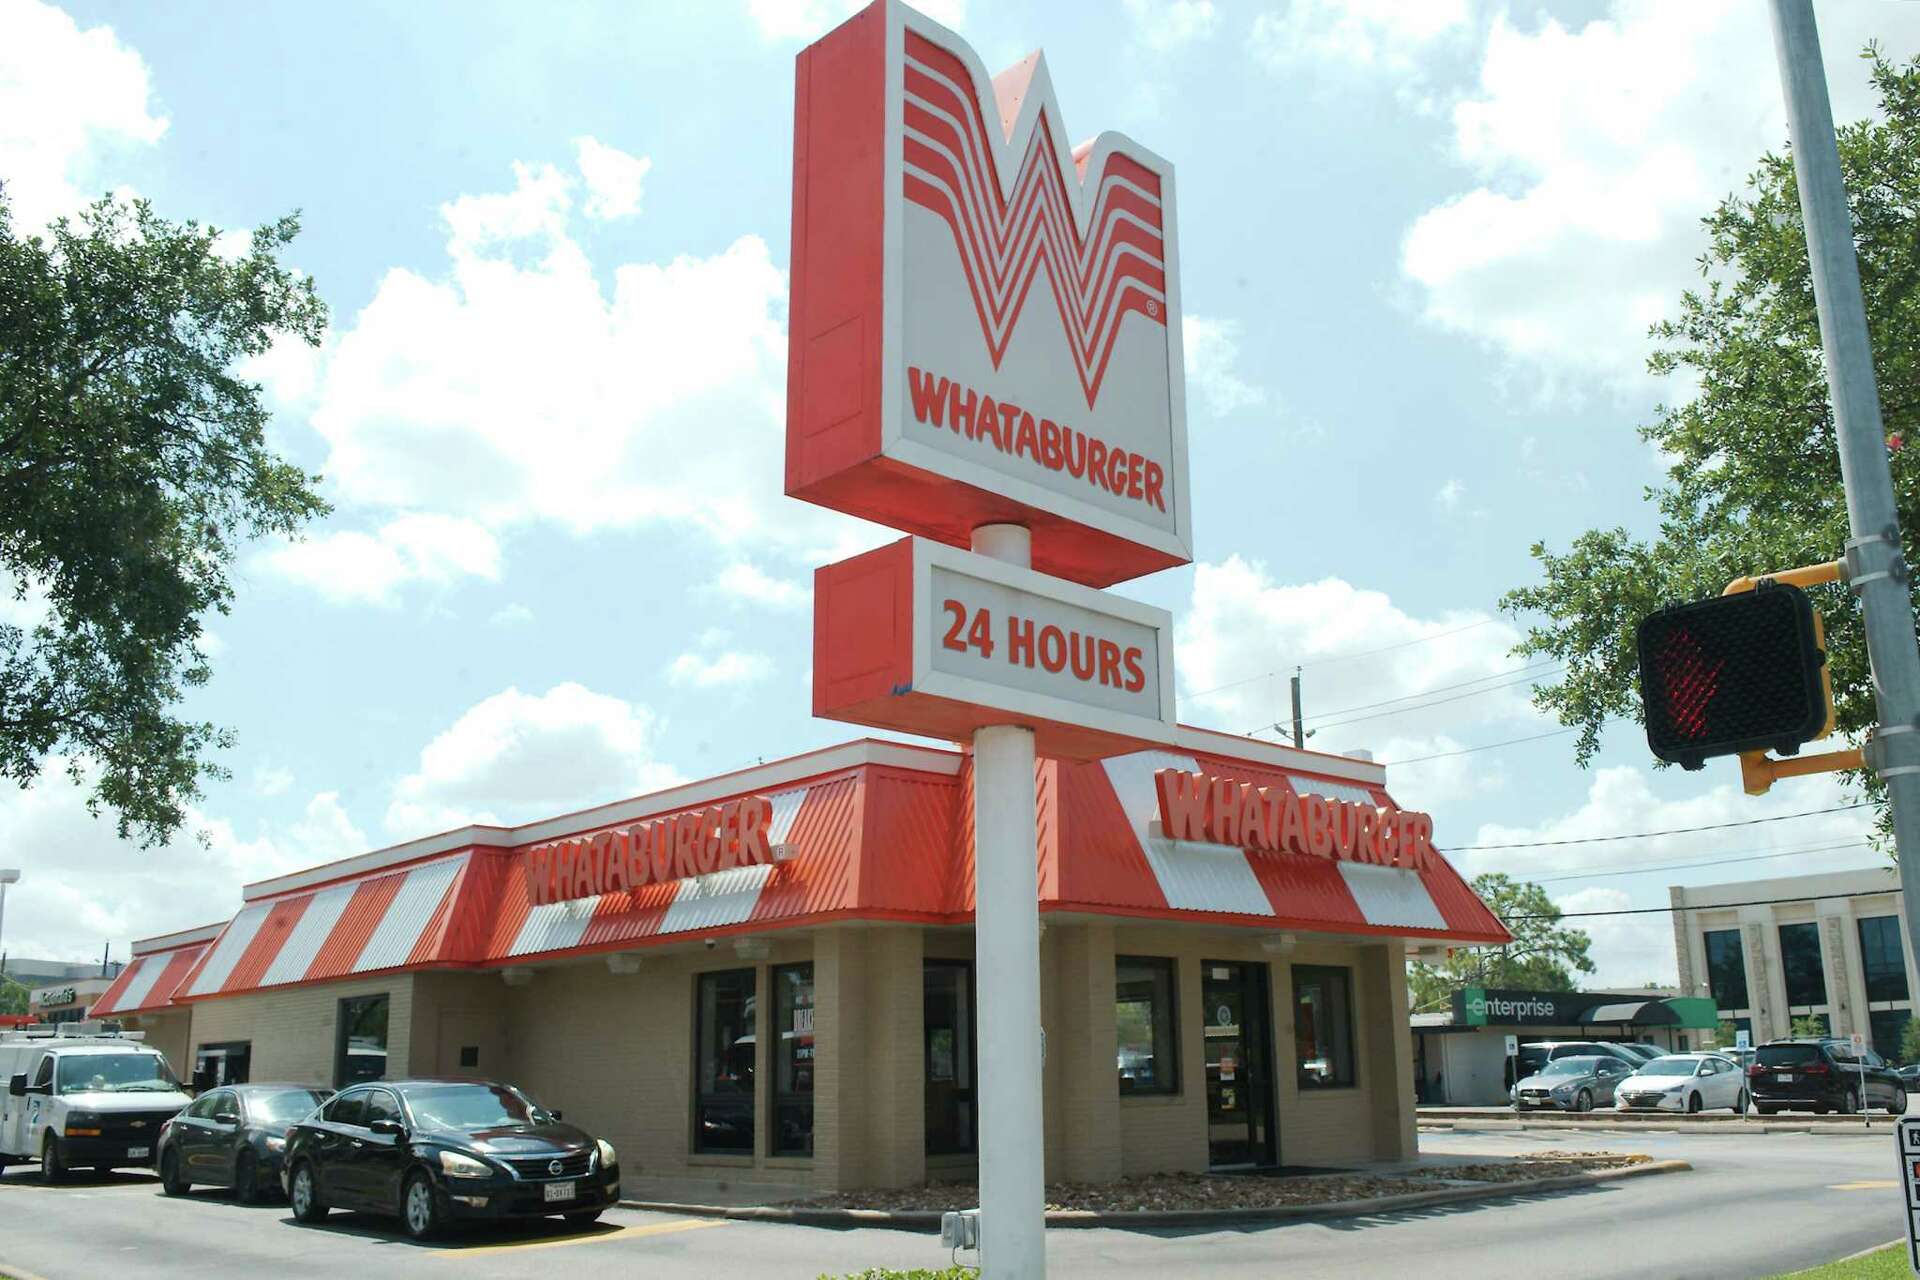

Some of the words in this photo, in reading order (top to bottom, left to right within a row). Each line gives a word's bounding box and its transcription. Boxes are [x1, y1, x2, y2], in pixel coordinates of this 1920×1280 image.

[907, 366, 1167, 513] WHATABURGER
[943, 599, 995, 660] 24
[1008, 616, 1146, 694] HOURS
[522, 796, 775, 905] WHATABURGER
[1154, 767, 1435, 873] WHATABURGER
[1467, 996, 1555, 1021] enterprise
